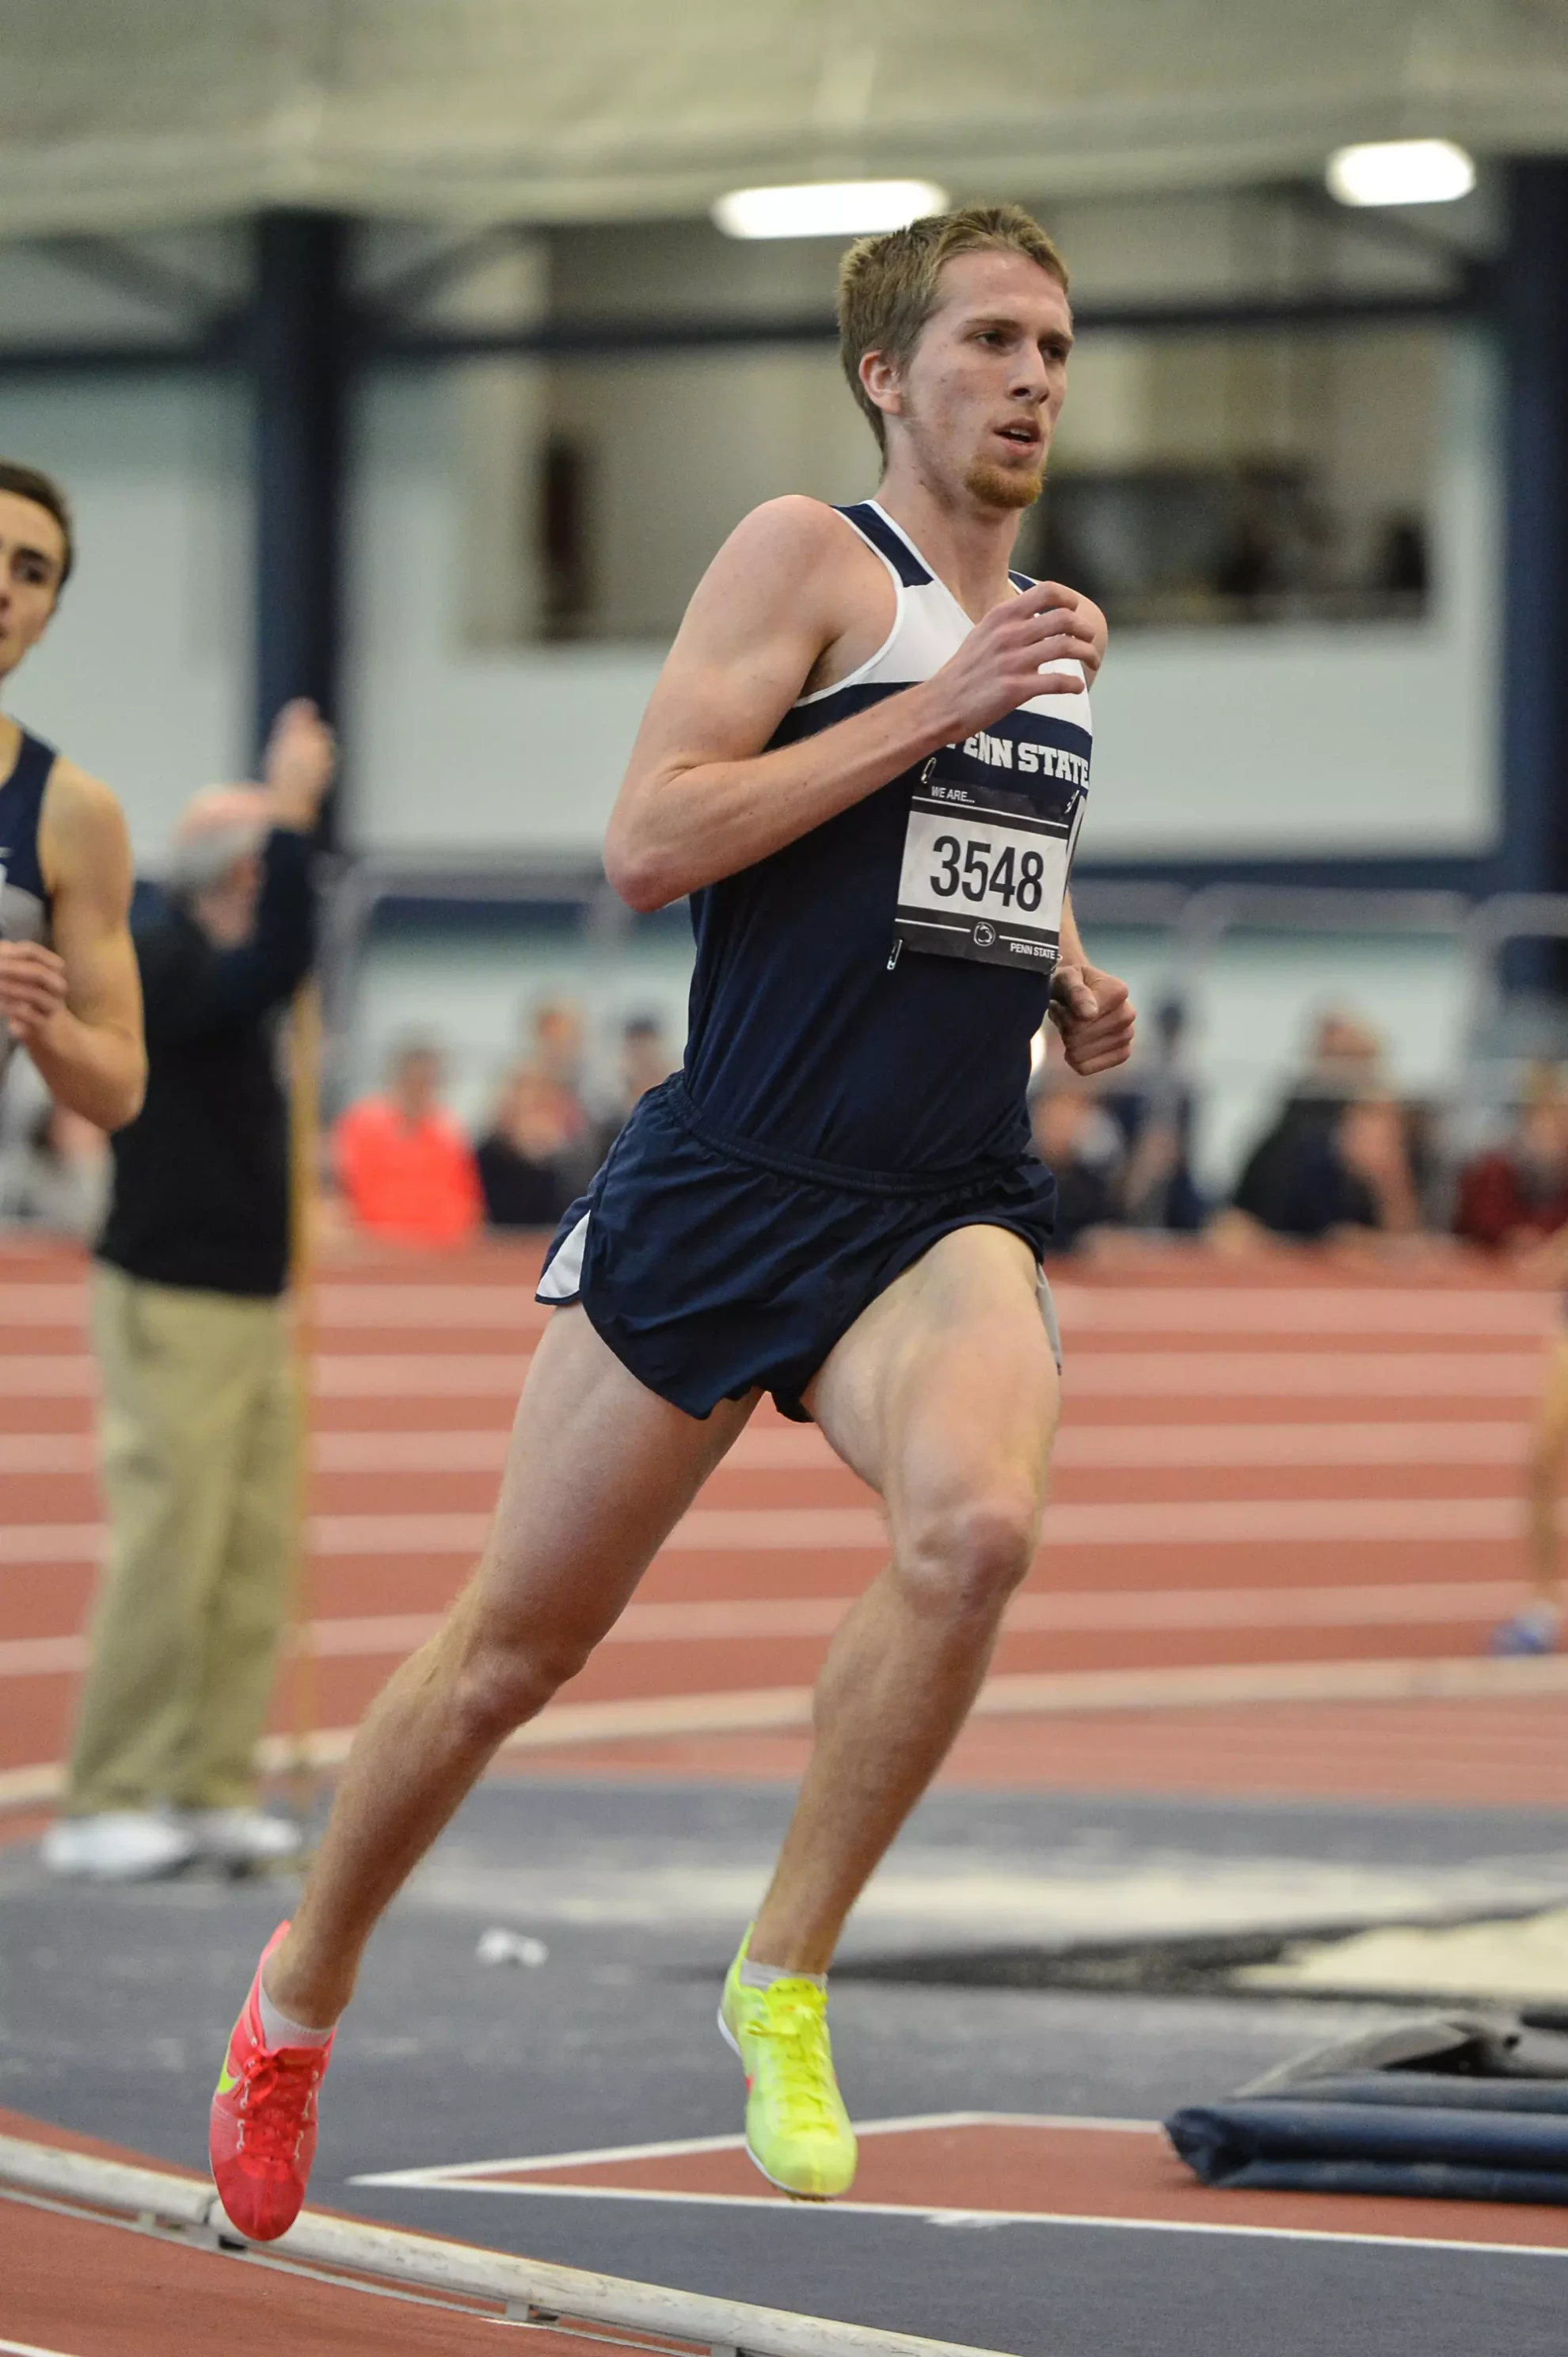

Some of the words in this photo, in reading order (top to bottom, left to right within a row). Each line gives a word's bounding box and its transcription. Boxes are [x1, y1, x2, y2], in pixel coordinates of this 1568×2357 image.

[946, 731, 1013, 769] ENN
[1018, 742, 1090, 790] STATE
[931, 786, 946, 798] WE
[930, 836, 1045, 912] 3548
[1010, 942, 1033, 955] PENN
[1033, 946, 1056, 960] STATE
